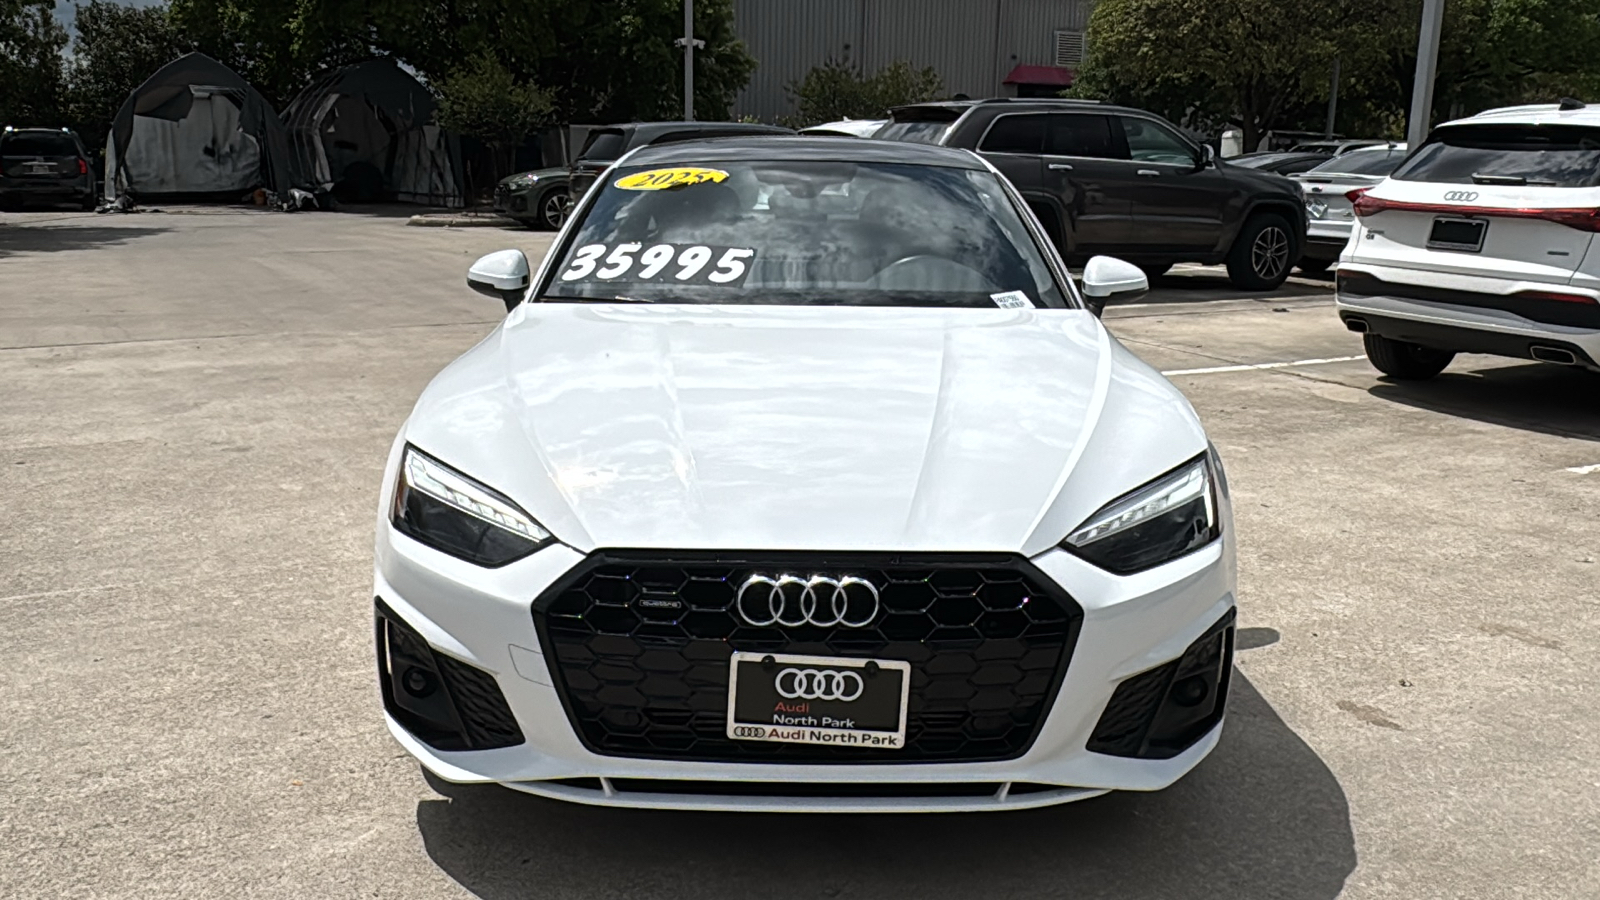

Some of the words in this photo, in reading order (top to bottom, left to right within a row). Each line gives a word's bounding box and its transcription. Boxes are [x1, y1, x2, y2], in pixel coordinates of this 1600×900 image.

[632, 171, 712, 187] 2025
[561, 243, 754, 284] 35995
[774, 701, 810, 714] Audi
[773, 714, 818, 727] North
[821, 717, 855, 728] Park
[768, 728, 806, 741] Audi
[809, 731, 858, 744] North
[861, 734, 898, 746] Park
